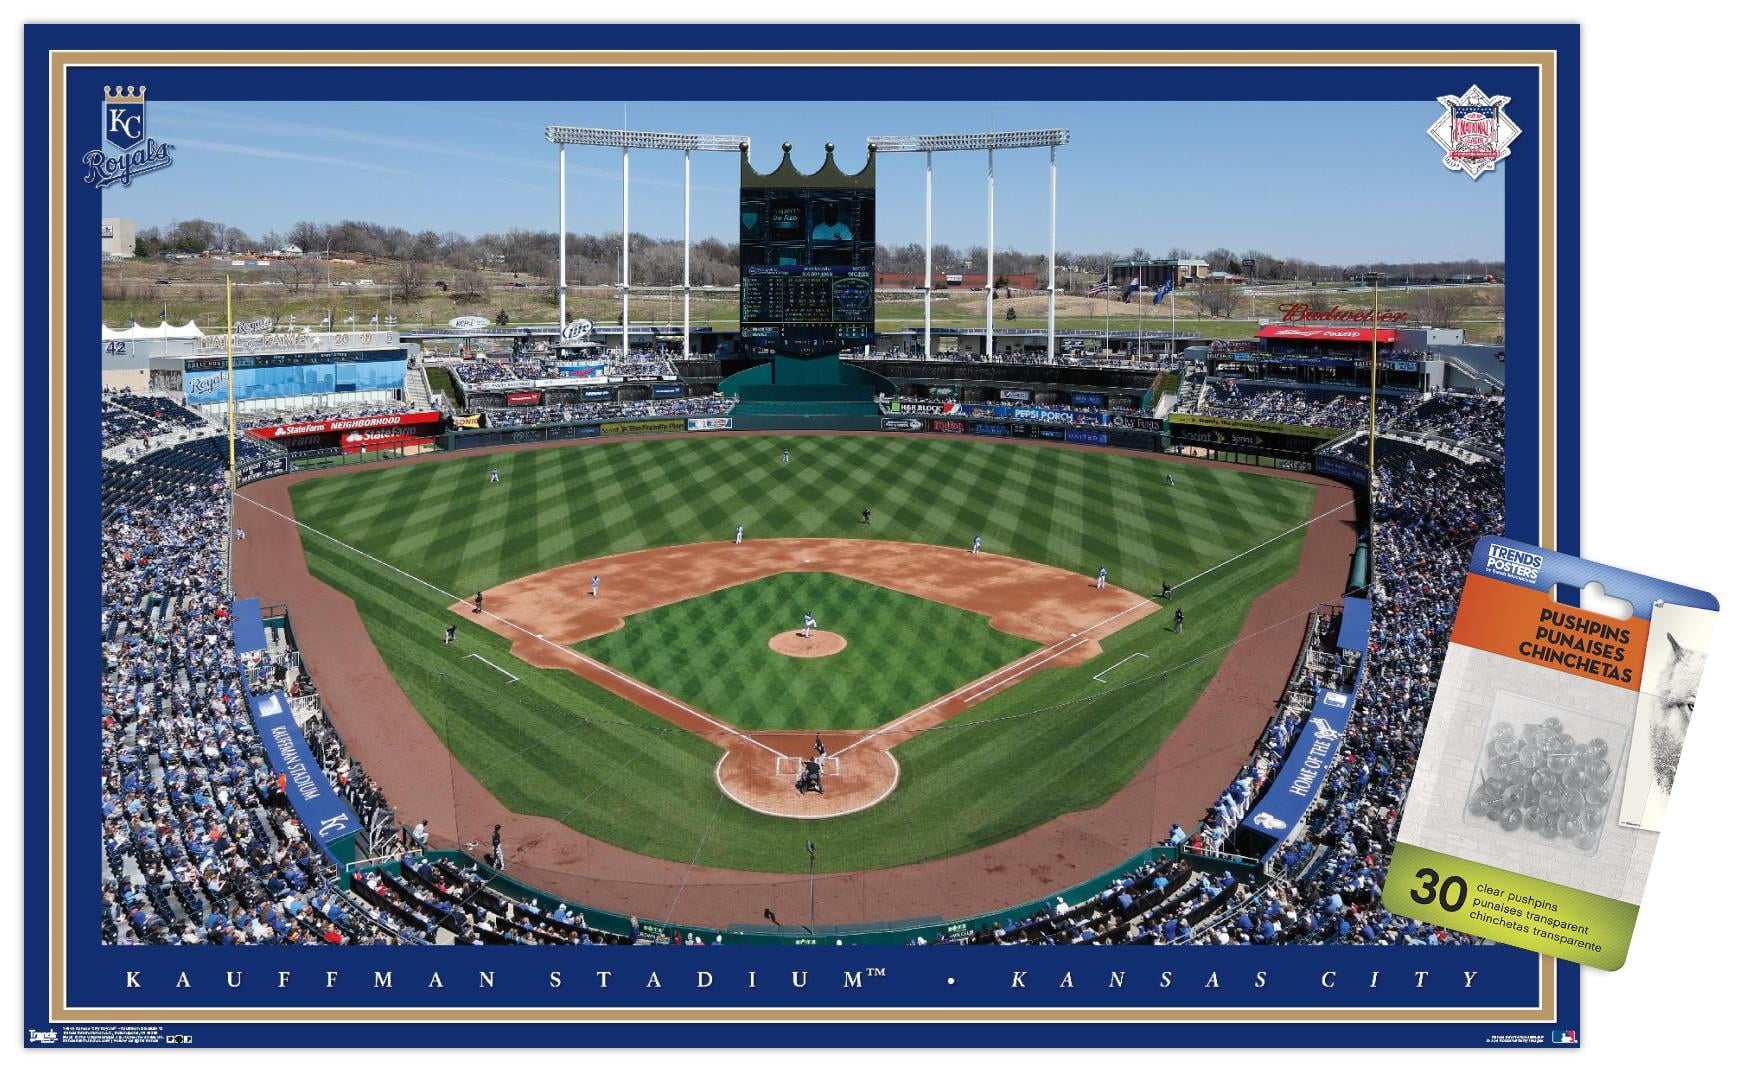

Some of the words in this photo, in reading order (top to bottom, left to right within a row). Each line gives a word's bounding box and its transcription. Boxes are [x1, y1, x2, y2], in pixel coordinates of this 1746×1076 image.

[109, 108, 141, 139] KC
[82, 137, 172, 189] Royals
[106, 341, 126, 354] 42
[901, 404, 915, 412] H&R
[1015, 409, 1039, 418] PEPSI
[1041, 410, 1073, 422] PORCH
[330, 416, 401, 430] NEIGHBORHOOD
[454, 418, 478, 427] SONIC
[1231, 435, 1253, 445] Sprint
[1487, 557, 1538, 579] POSTERS
[1491, 545, 1542, 568] TRENDS
[1540, 608, 1631, 645] PUSHPINS
[1536, 626, 1625, 662] PUNAISES
[1519, 641, 1632, 683] CHINCHETAS
[1310, 740, 1331, 757] THE
[271, 724, 300, 765] KAUFFMAN
[287, 758, 320, 801] STADIUM
[1304, 755, 1323, 769] OF
[1289, 767, 1318, 797] HOME
[319, 813, 349, 838] KC
[1410, 867, 1468, 912] 30
[1477, 883, 1505, 898] clear
[1507, 892, 1558, 912] pushpins
[1472, 897, 1522, 917] punaises
[1526, 911, 1590, 935] transparent
[1469, 910, 1529, 934] chinchetas
[1533, 926, 1602, 953] transparente
[126, 971, 494, 988] KAUFFMAN
[1010, 971, 1267, 988] KANSAS
[1321, 971, 1478, 988] CITY
